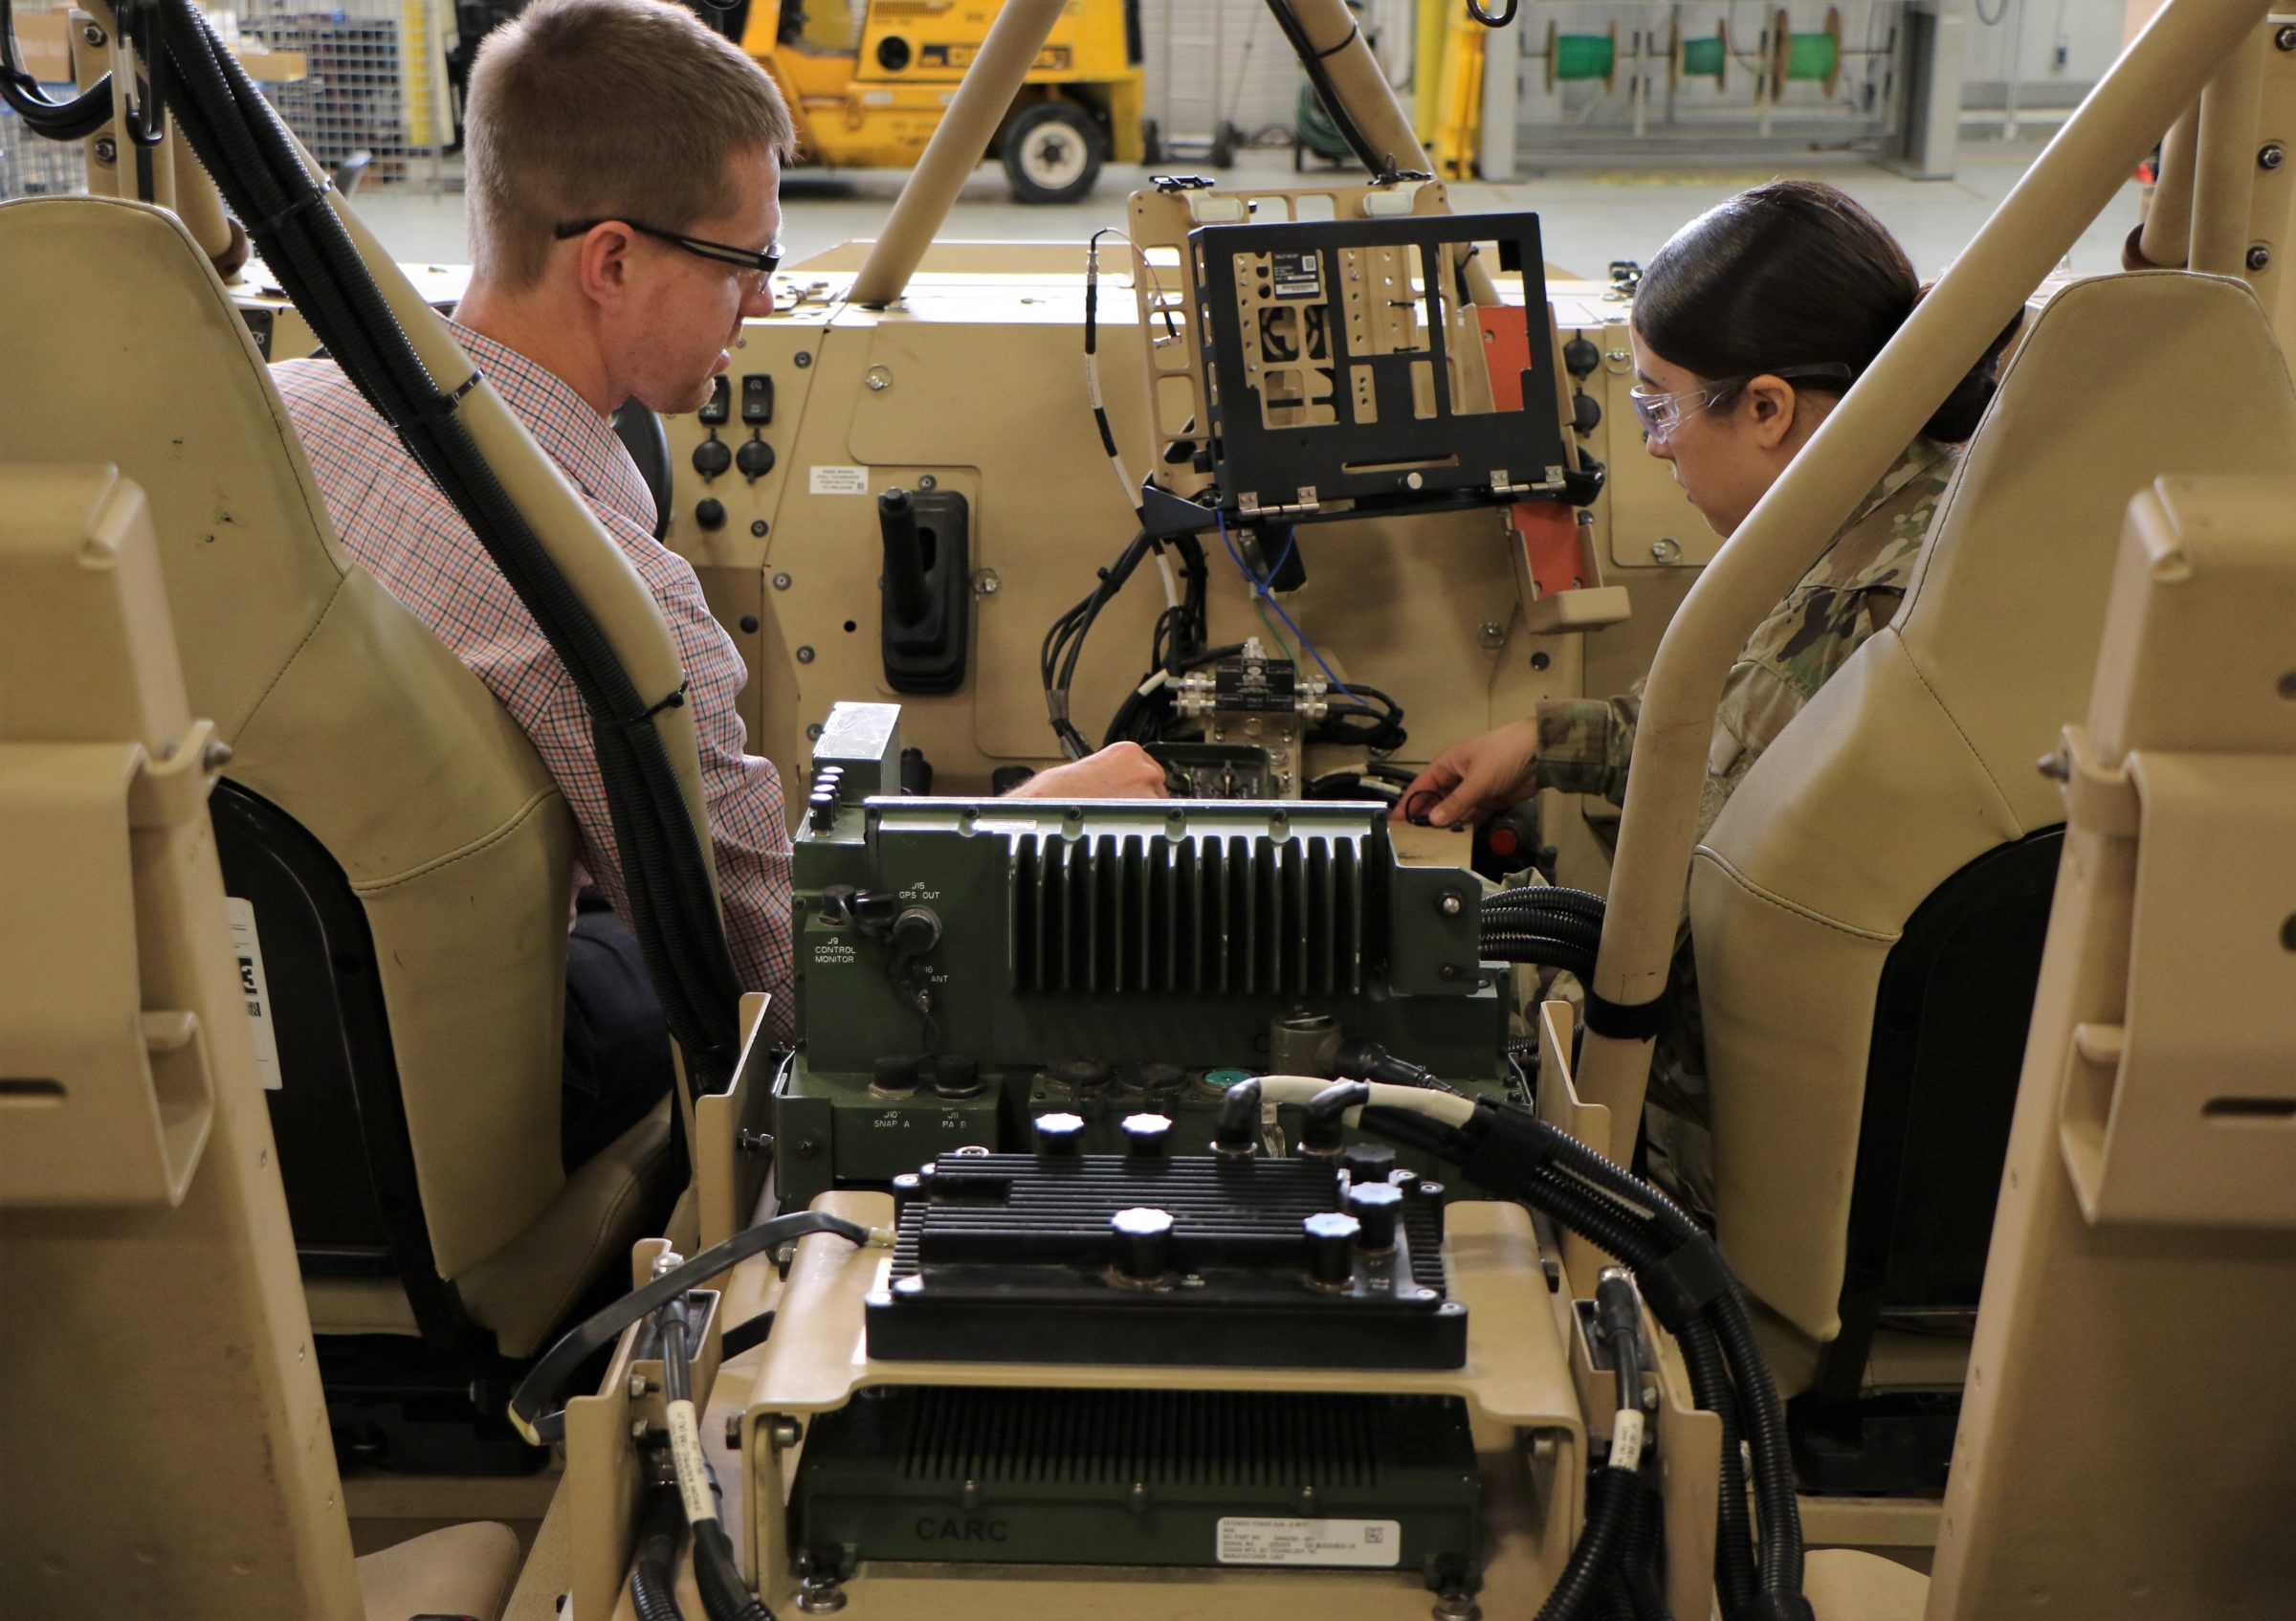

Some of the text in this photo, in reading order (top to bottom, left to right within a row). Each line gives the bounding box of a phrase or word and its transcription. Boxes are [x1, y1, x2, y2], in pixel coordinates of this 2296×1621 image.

[898, 891, 916, 899] GPS
[815, 945, 856, 954] CONTROL
[873, 1120, 898, 1128] SNAP
[916, 1517, 1009, 1543] CARC
